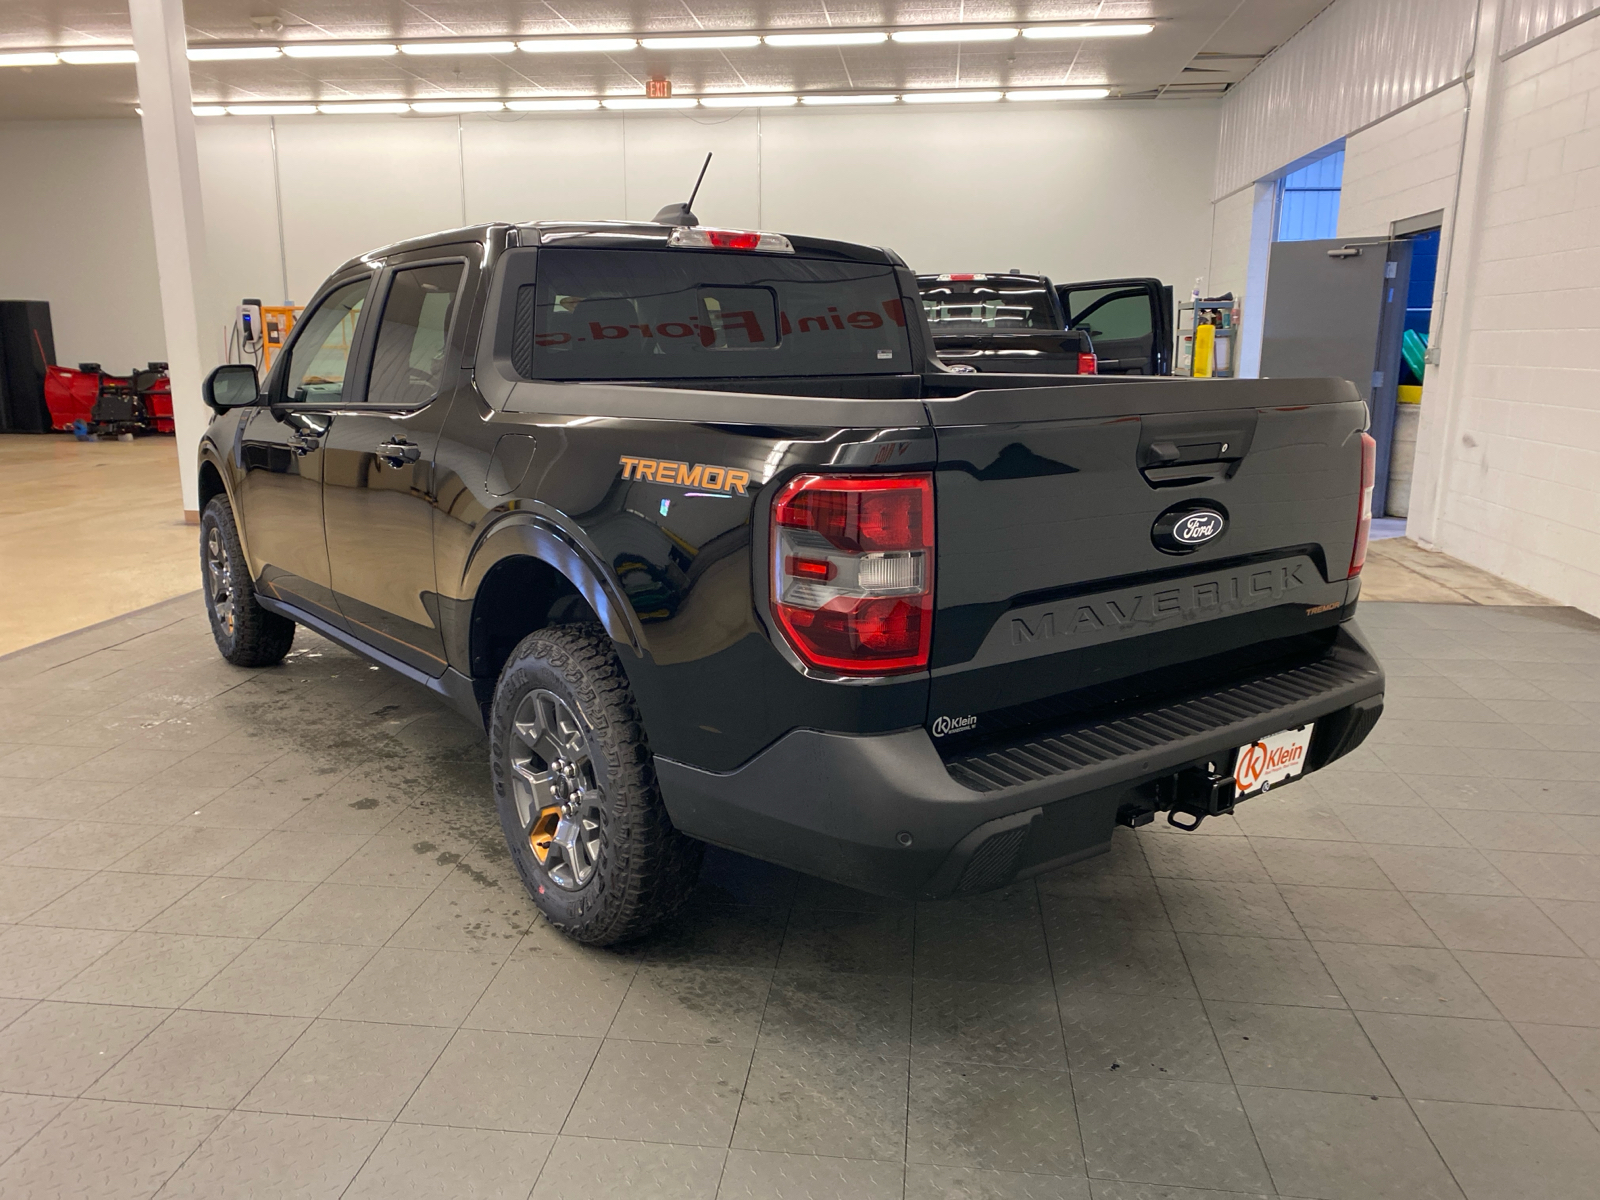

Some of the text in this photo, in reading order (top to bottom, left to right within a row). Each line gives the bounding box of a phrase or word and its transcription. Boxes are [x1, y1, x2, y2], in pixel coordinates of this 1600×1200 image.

[650, 82, 668, 97] EXIT
[619, 455, 750, 497] TREMOR
[1183, 516, 1215, 539] Ford
[1011, 564, 1304, 646] MAVERICK
[1305, 601, 1340, 616] TREMOR
[951, 715, 977, 729] Klein
[1266, 742, 1303, 770] Klein
